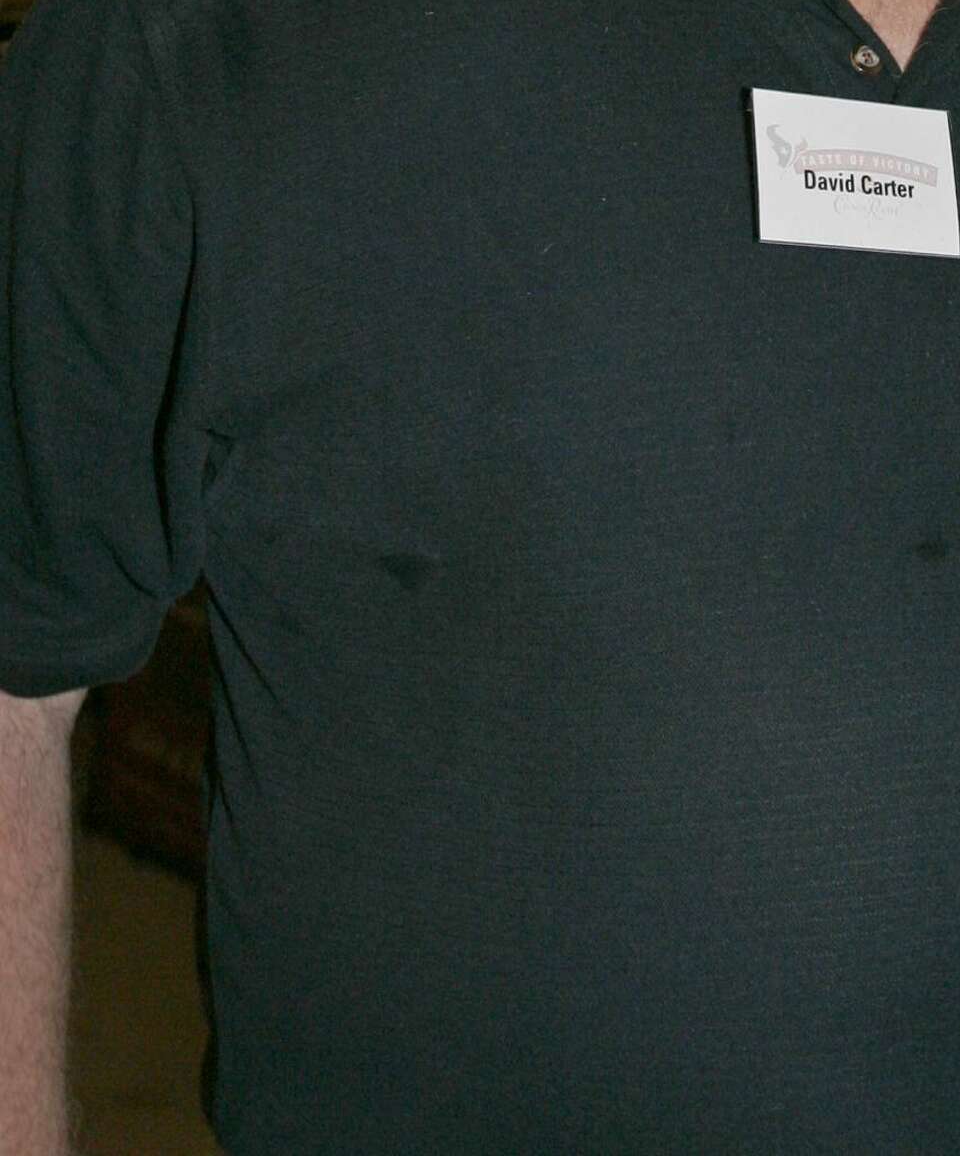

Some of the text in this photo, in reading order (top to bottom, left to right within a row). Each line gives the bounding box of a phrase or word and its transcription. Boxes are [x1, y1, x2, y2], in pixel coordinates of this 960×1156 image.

[799, 153, 930, 180] TASTE OF VICTORY
[803, 169, 915, 198] David Carter
